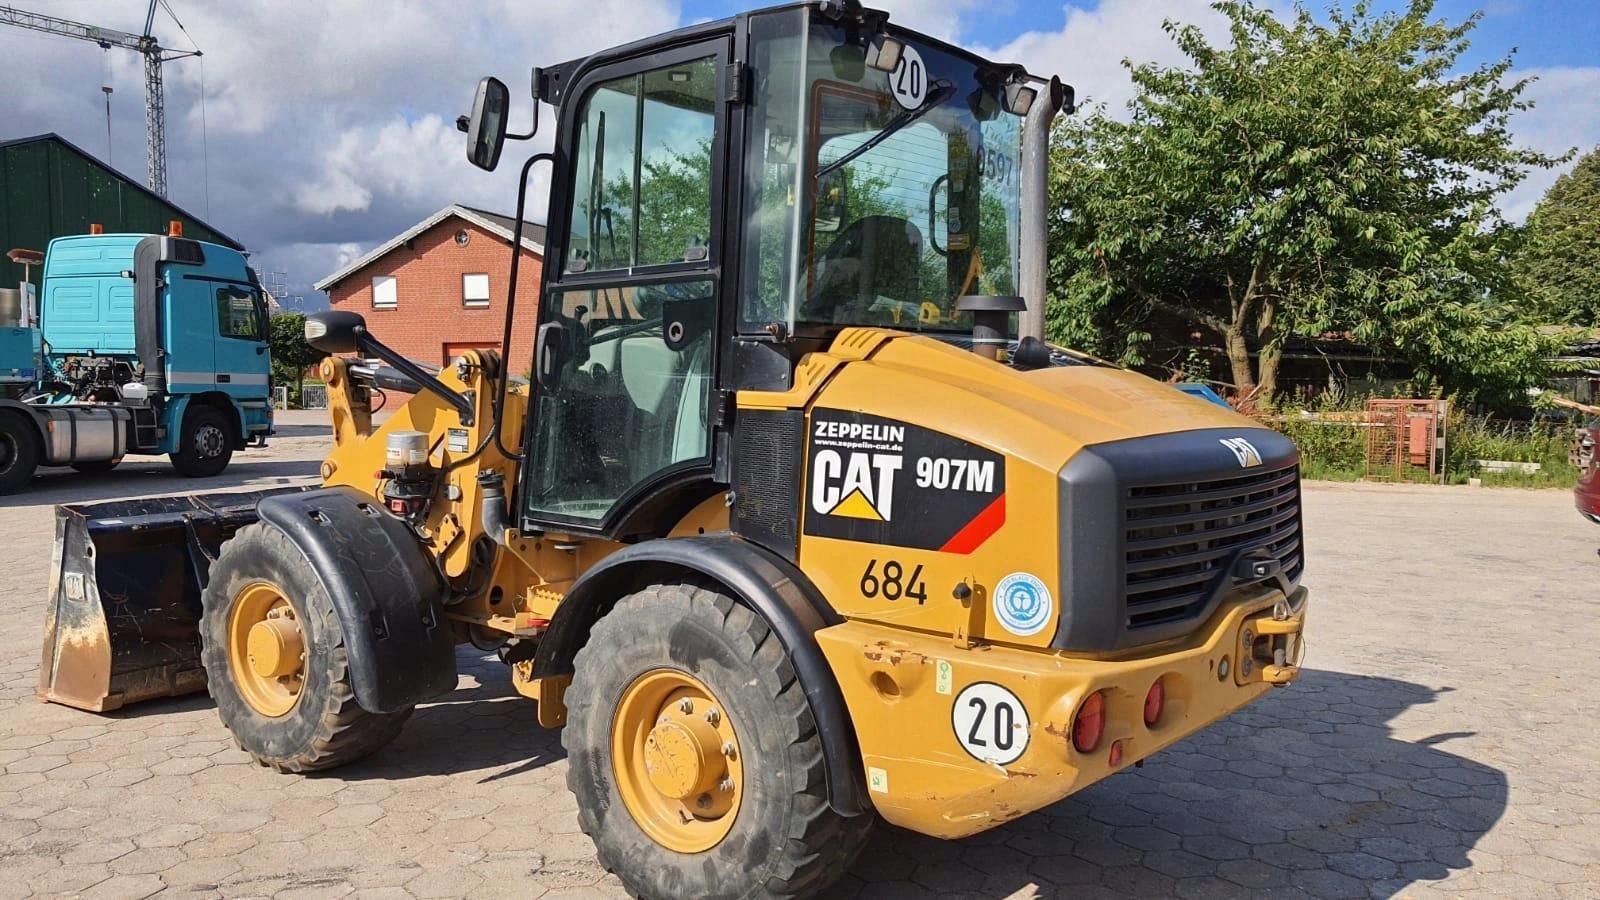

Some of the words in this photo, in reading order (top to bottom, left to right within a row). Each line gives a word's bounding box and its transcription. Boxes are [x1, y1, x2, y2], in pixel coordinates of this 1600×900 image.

[897, 56, 920, 98] 20
[814, 420, 905, 442] ZEPPELIN
[814, 439, 903, 452] www.zeppelin-cat.de
[812, 449, 903, 521] CAT
[915, 456, 995, 492] 907M
[860, 559, 927, 605] 684
[968, 696, 1014, 750] 20
